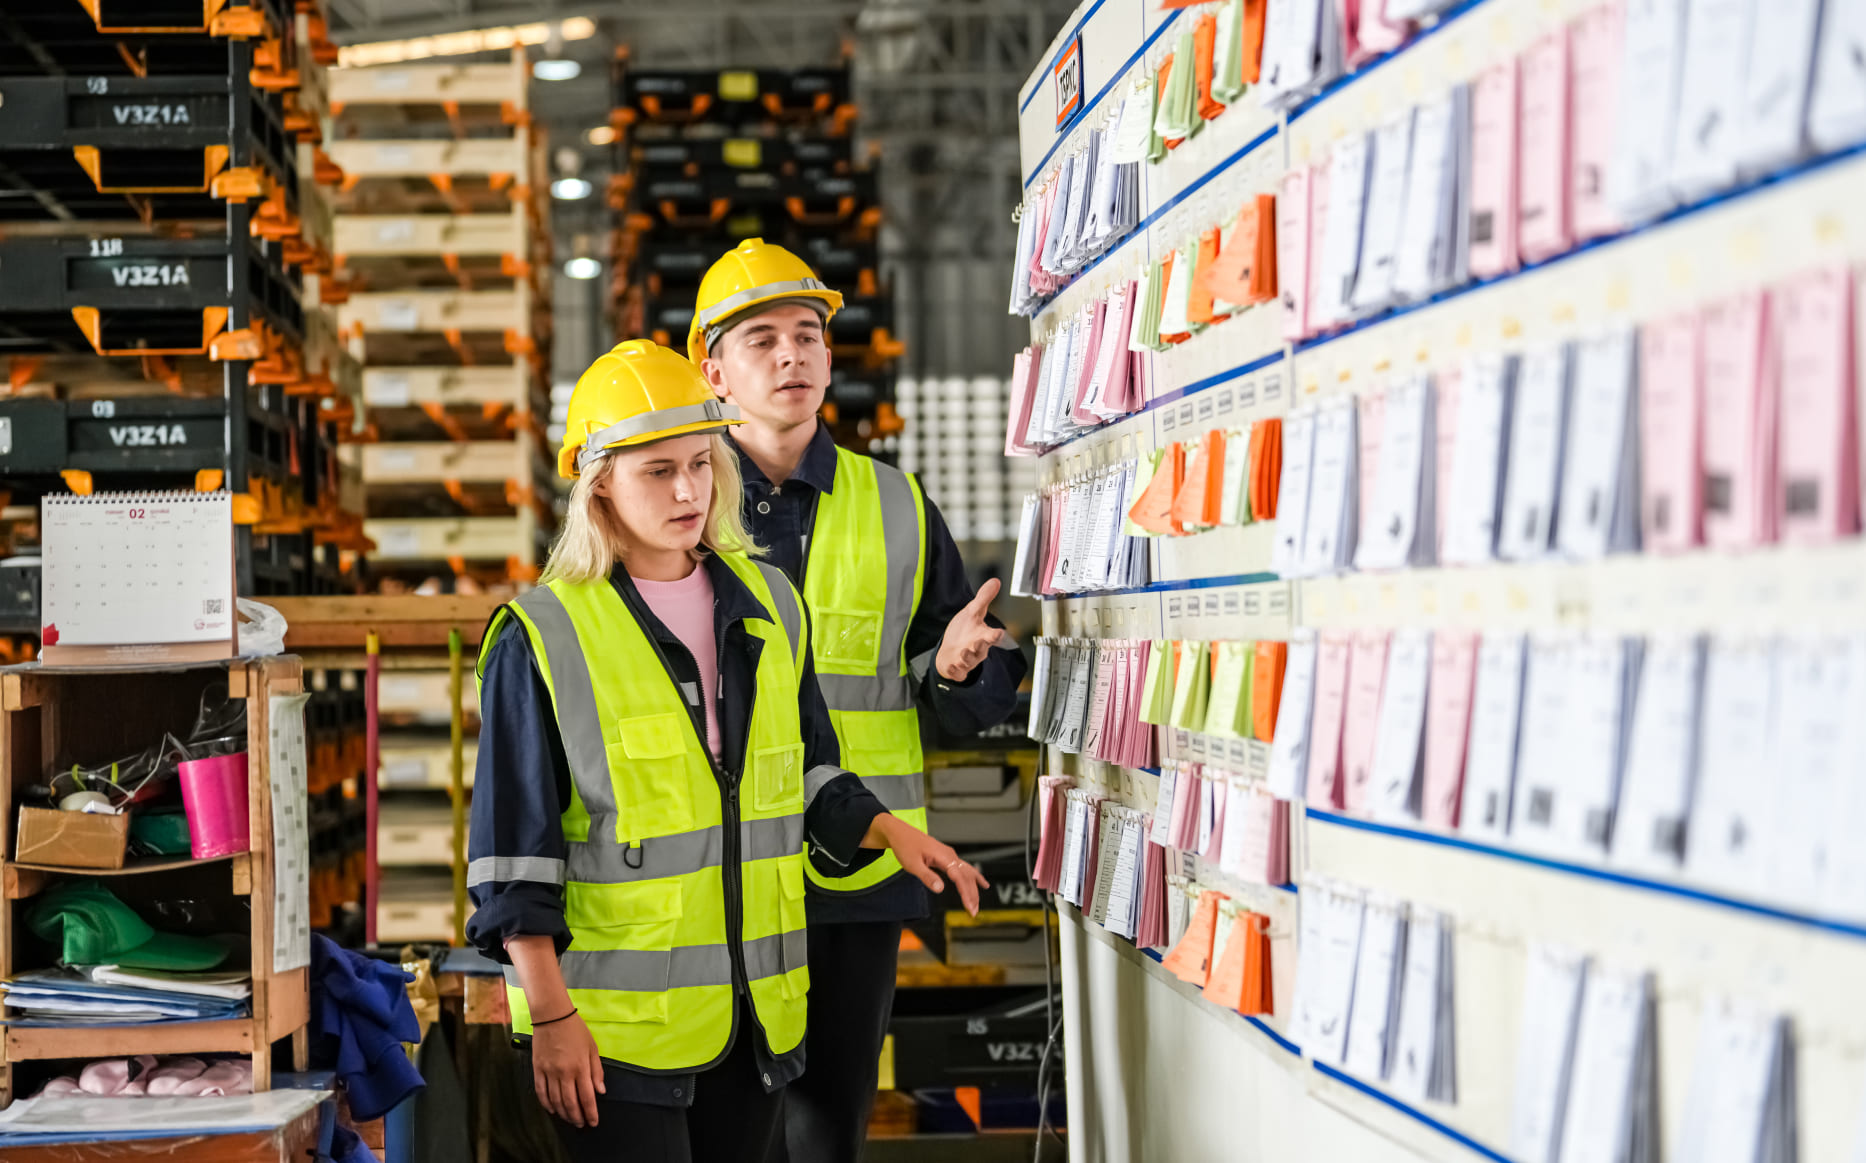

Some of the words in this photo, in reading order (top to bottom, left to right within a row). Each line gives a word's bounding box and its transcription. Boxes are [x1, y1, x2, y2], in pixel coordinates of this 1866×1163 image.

[113, 105, 189, 124] V3Z1A
[112, 265, 189, 287] V3Z1A
[109, 425, 187, 446] V3Z1A
[129, 508, 145, 519] 02
[996, 882, 1043, 905] V3Z
